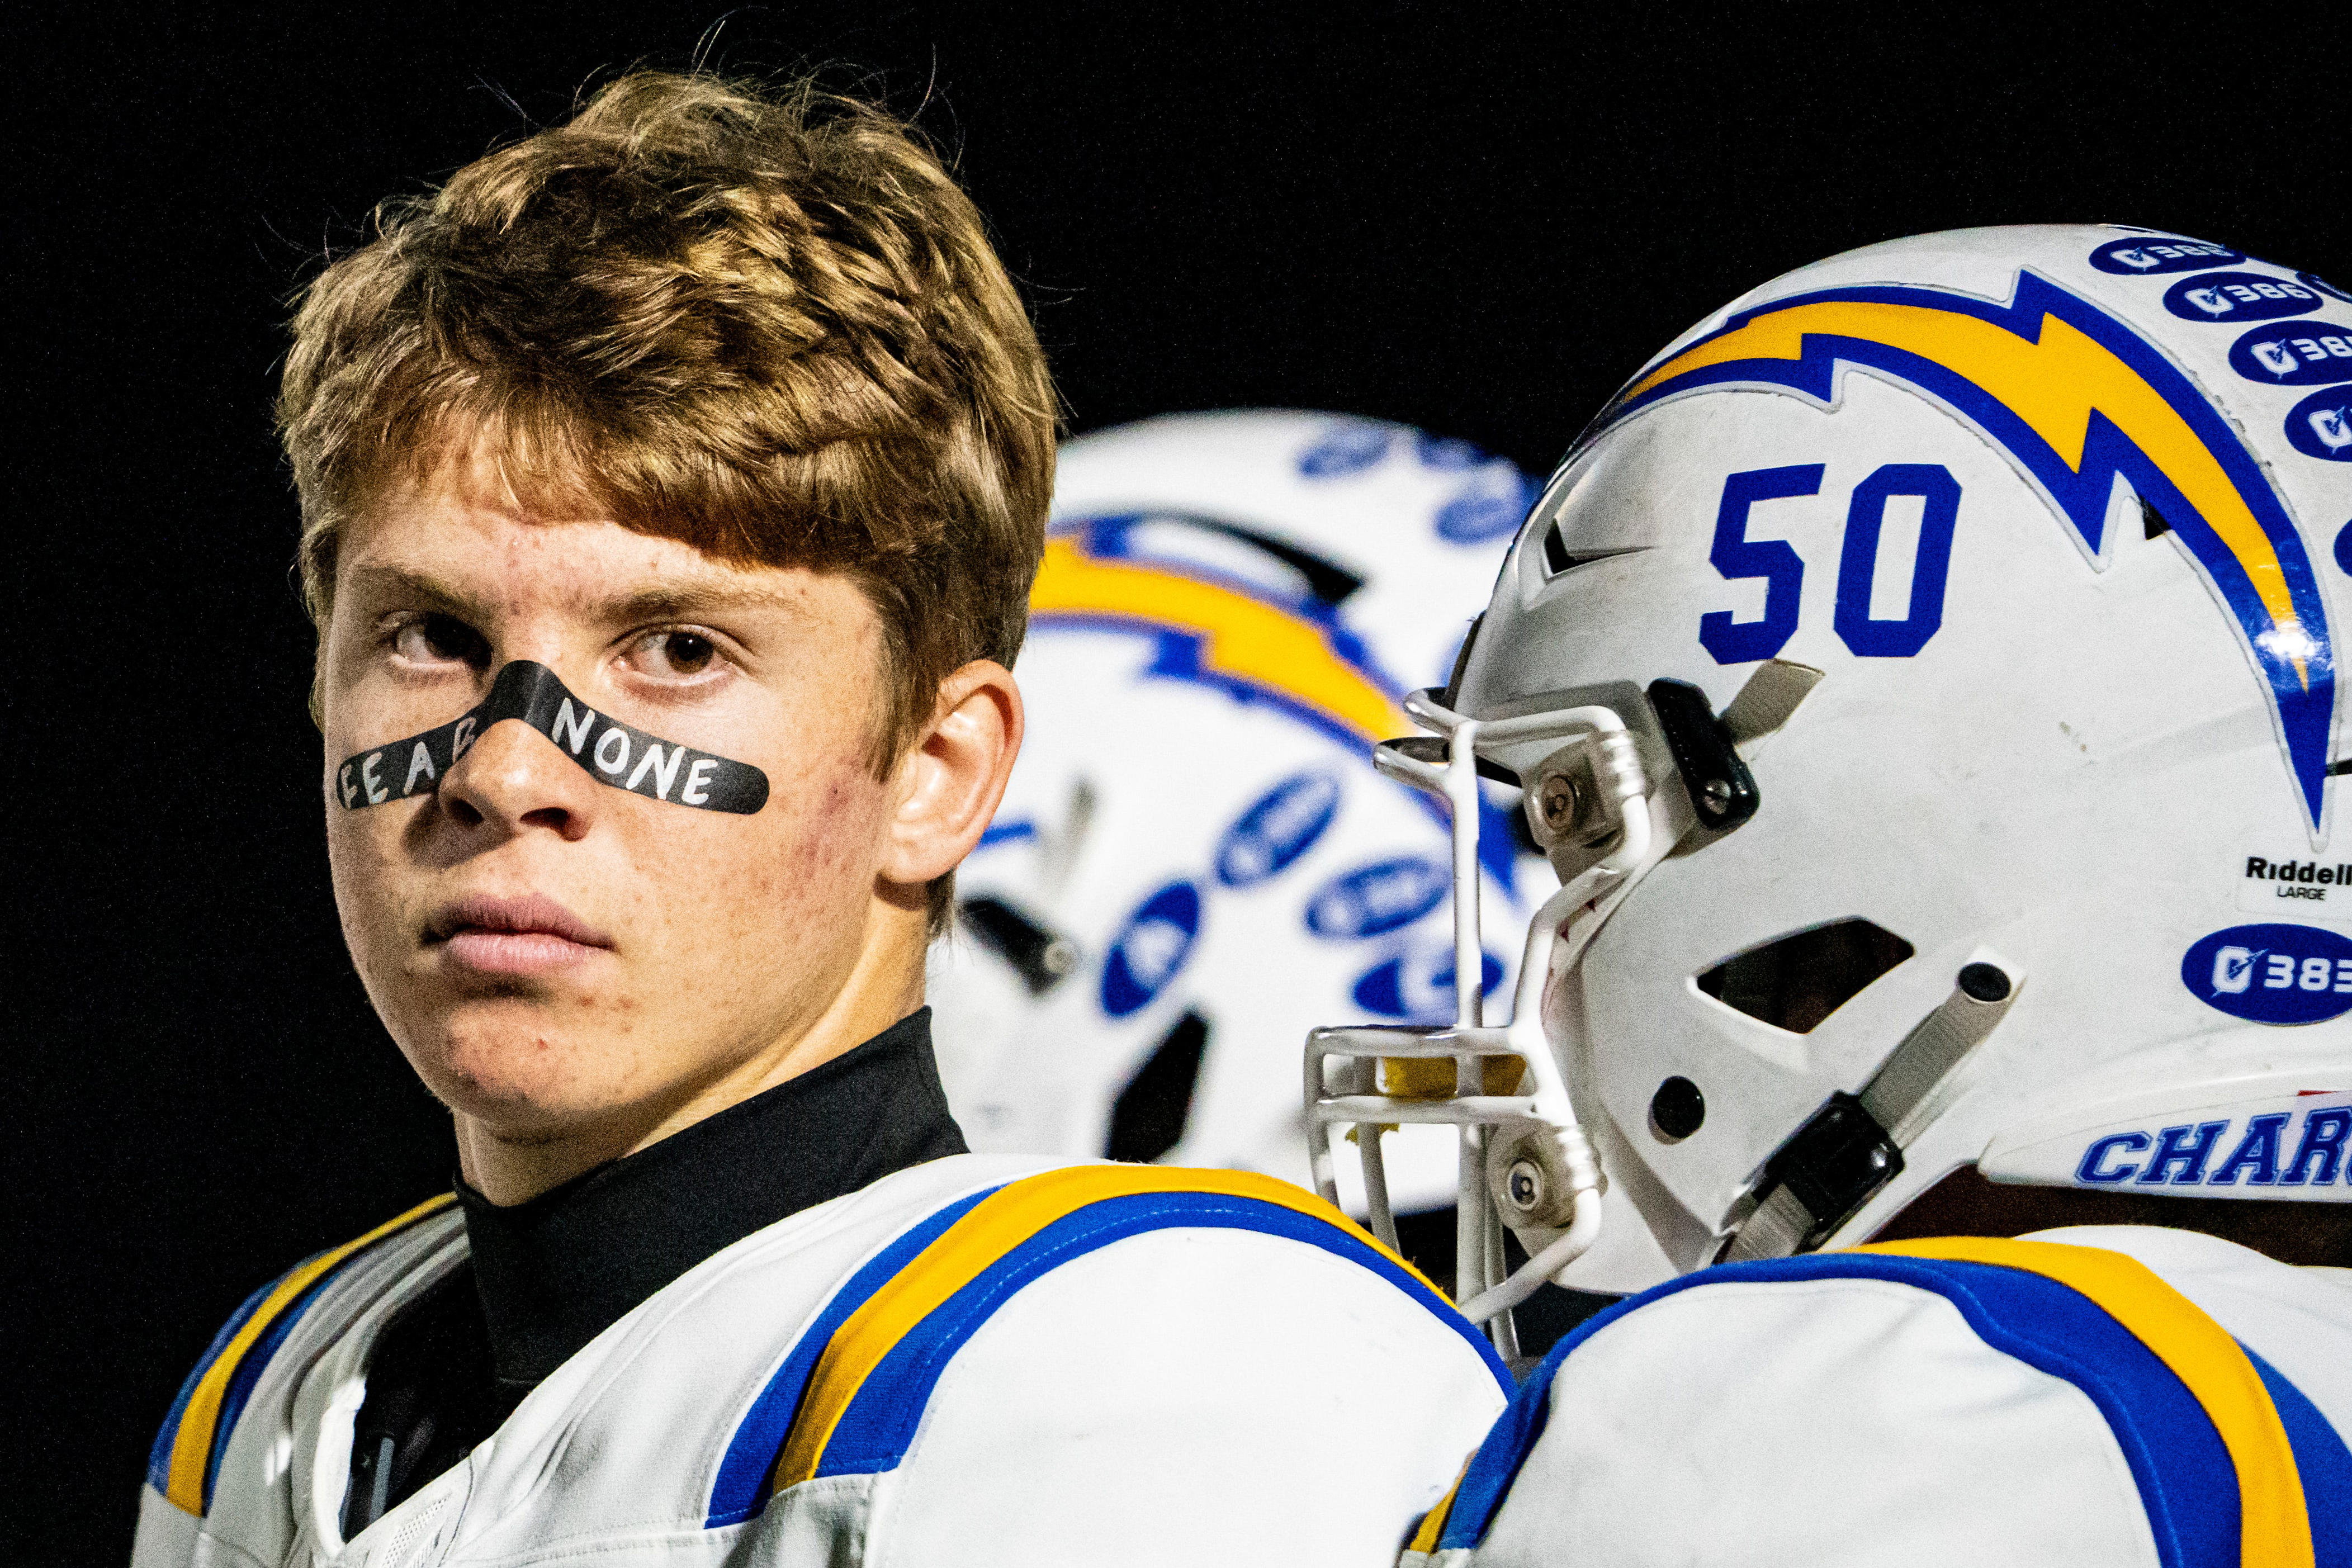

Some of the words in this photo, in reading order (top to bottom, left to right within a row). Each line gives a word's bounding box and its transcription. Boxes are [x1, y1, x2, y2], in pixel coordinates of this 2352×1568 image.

[2223, 283, 2313, 302] 386
[1699, 463, 1962, 665] 50
[551, 697, 718, 805] NONE
[2245, 856, 2352, 885] Riddell
[2277, 885, 2326, 901] LARGE
[2075, 1105, 2352, 1186] CHAR
